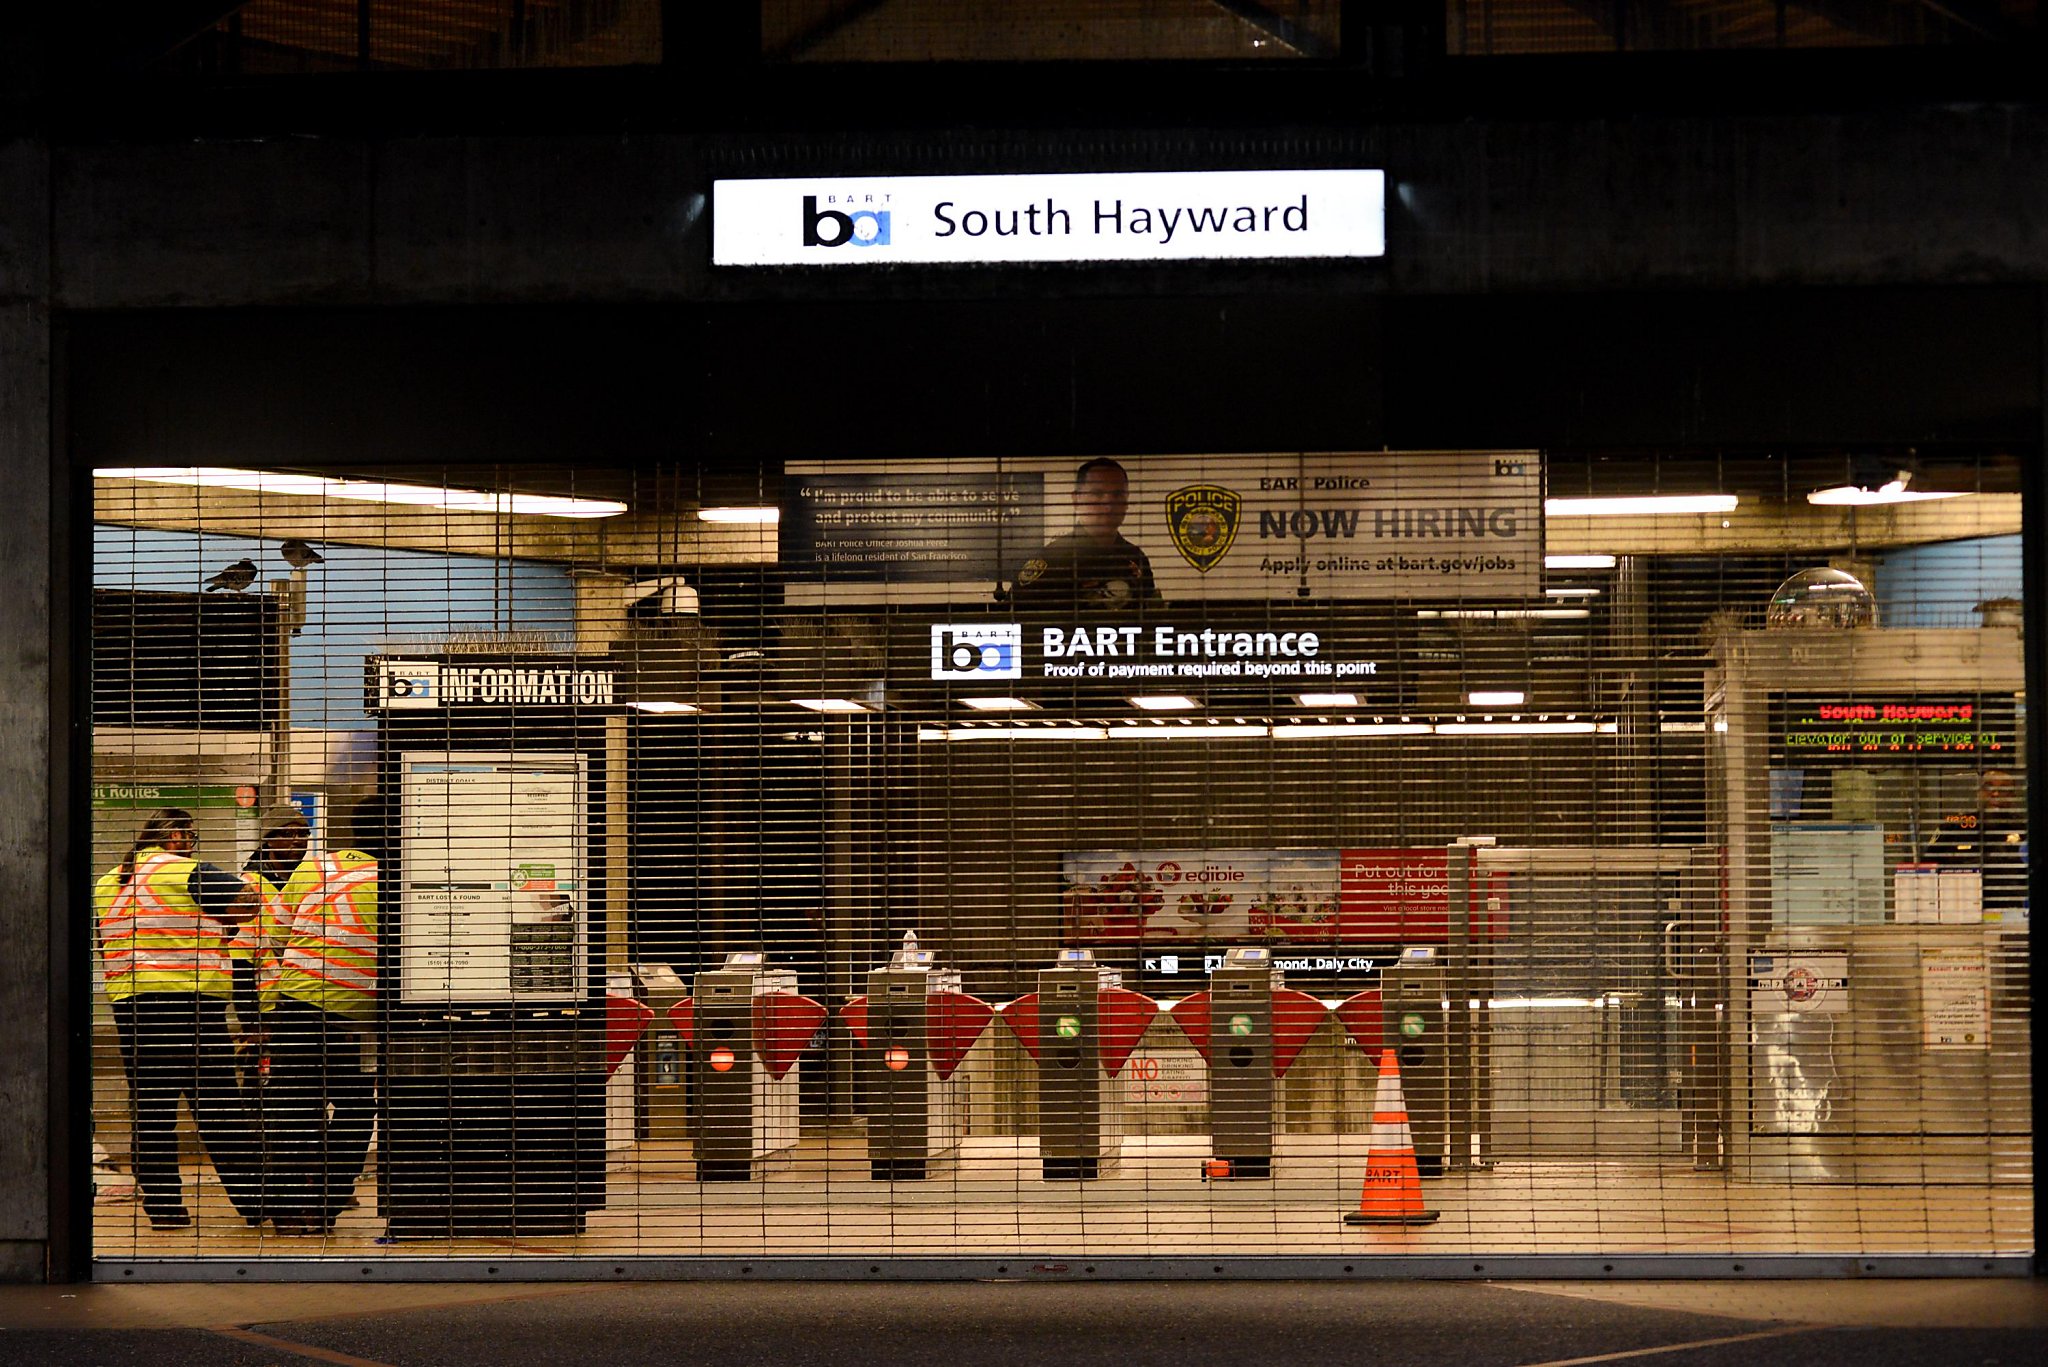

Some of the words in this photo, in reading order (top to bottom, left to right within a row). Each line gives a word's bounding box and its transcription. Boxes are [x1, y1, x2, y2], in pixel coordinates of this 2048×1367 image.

[828, 194, 892, 203] BART
[934, 196, 1071, 238] South
[1094, 194, 1309, 244] Hayward
[1260, 477, 1308, 490] BAR
[1314, 476, 1370, 490] Police
[840, 488, 881, 506] proud
[886, 489, 901, 502] to
[906, 487, 924, 502] be
[927, 487, 958, 502] able
[963, 487, 978, 502] to
[981, 490, 1020, 502] seve
[1173, 491, 1234, 513] POLICE
[815, 510, 841, 524] and
[846, 510, 898, 526] protect
[902, 512, 922, 527] my
[1260, 508, 1360, 540] NOW
[1374, 507, 1516, 539] HIRING
[831, 552, 863, 563] lifelong
[865, 552, 898, 561] resident
[900, 551, 910, 561] of
[911, 551, 927, 561] San
[1316, 556, 1370, 571] online
[1375, 556, 1394, 570] at
[1399, 555, 1517, 573] bart.gov/jobs
[1043, 627, 1142, 658] BART
[1154, 626, 1320, 658] Entrance
[1044, 661, 1085, 677] Proof
[1088, 661, 1106, 677] of
[1108, 662, 1175, 678] payment
[1178, 660, 1241, 678] required
[1245, 661, 1300, 678] beyond
[1304, 661, 1332, 676] this
[1336, 660, 1378, 676] point
[441, 668, 613, 705] INFORMATION
[110, 783, 160, 798] Routes
[1185, 865, 1245, 881] edible
[1355, 864, 1381, 878] Put
[1385, 865, 1413, 878] out
[1418, 863, 1443, 878] for
[1388, 882, 1417, 896] this
[1316, 957, 1343, 972] Daly
[1348, 957, 1373, 972] City
[1131, 1058, 1158, 1080] NO
[1367, 1169, 1400, 1184] BART
